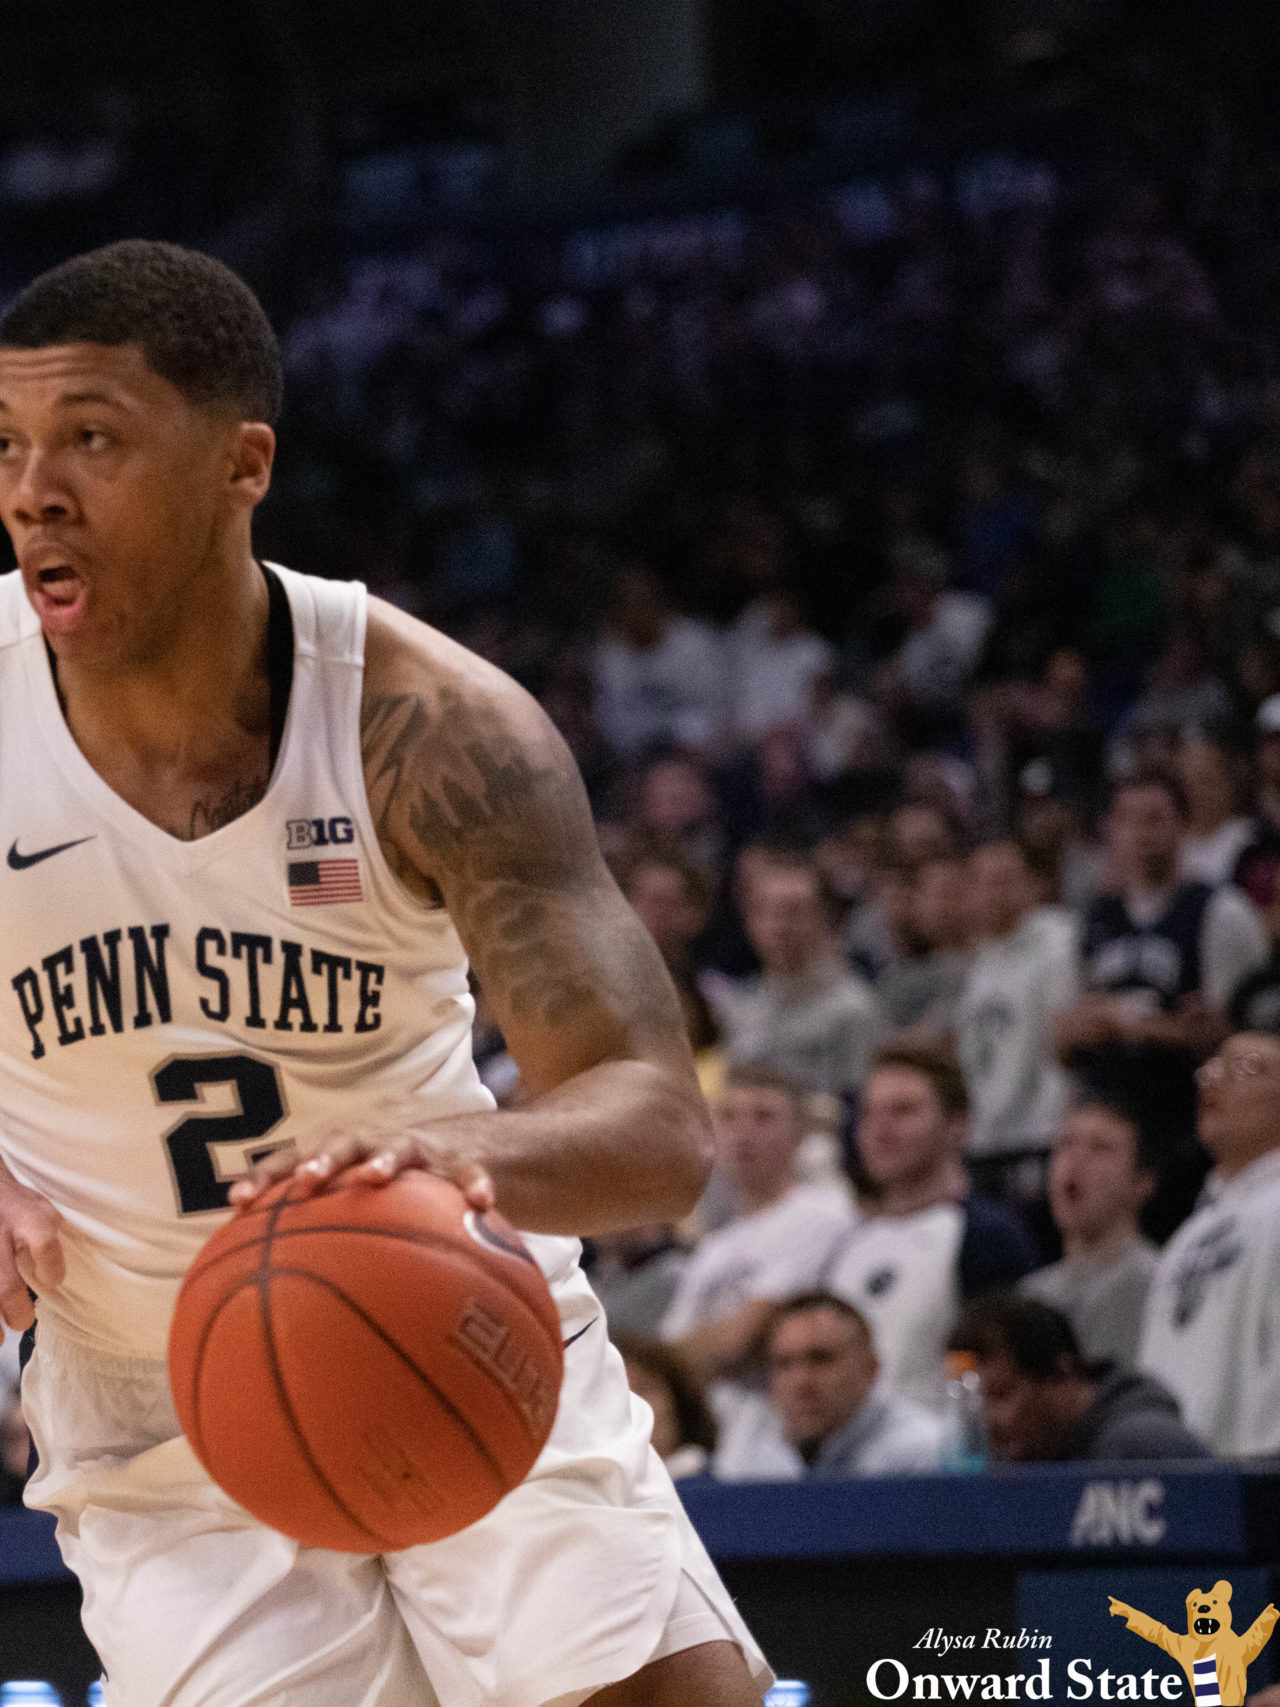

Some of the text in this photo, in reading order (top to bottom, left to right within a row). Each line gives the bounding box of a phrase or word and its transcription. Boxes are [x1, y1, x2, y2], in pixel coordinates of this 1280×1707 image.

[11, 923, 386, 1060] PENN STATE
[148, 1052, 296, 1219] 2
[1070, 1480, 1166, 1547] ANC
